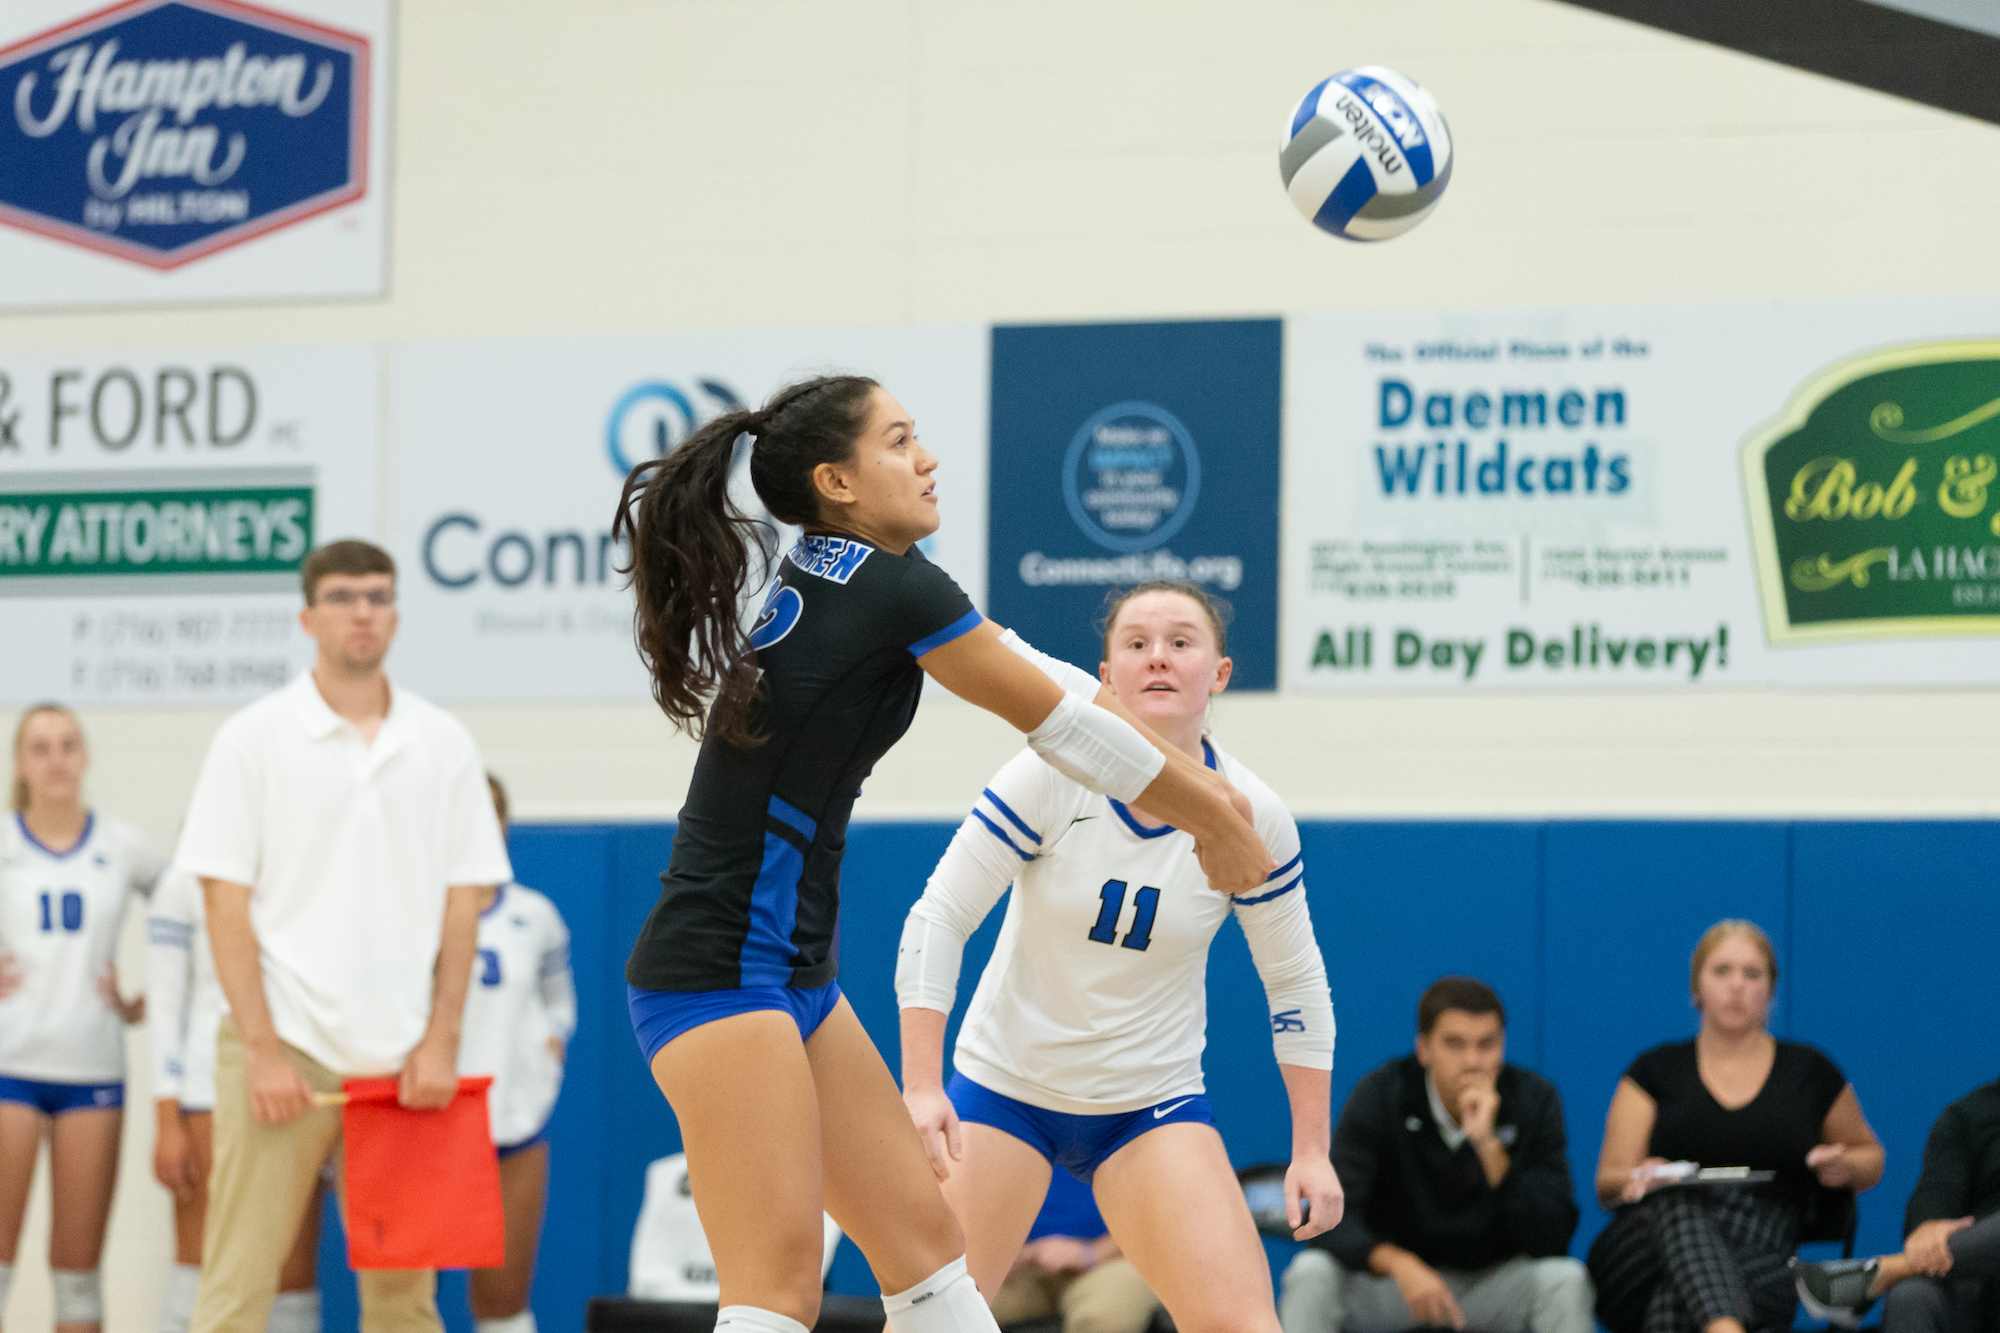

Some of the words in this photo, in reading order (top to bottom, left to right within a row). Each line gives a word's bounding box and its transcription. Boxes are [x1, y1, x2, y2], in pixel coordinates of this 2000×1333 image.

[15, 38, 334, 138] Hampton
[86, 109, 247, 200] Inn
[1336, 94, 1402, 176] molten
[50, 365, 258, 452] FORD
[1376, 376, 1628, 431] Daemen
[1374, 438, 1632, 497] Wildcats
[1785, 456, 1917, 523] Bob
[1937, 452, 1997, 518] &
[51, 499, 307, 565] ATTORNEYS
[1311, 626, 1374, 670] All
[1395, 628, 1485, 682] Day
[1507, 621, 1729, 681] Delivery!
[39, 889, 83, 934] 10
[1088, 879, 1161, 952] 11
